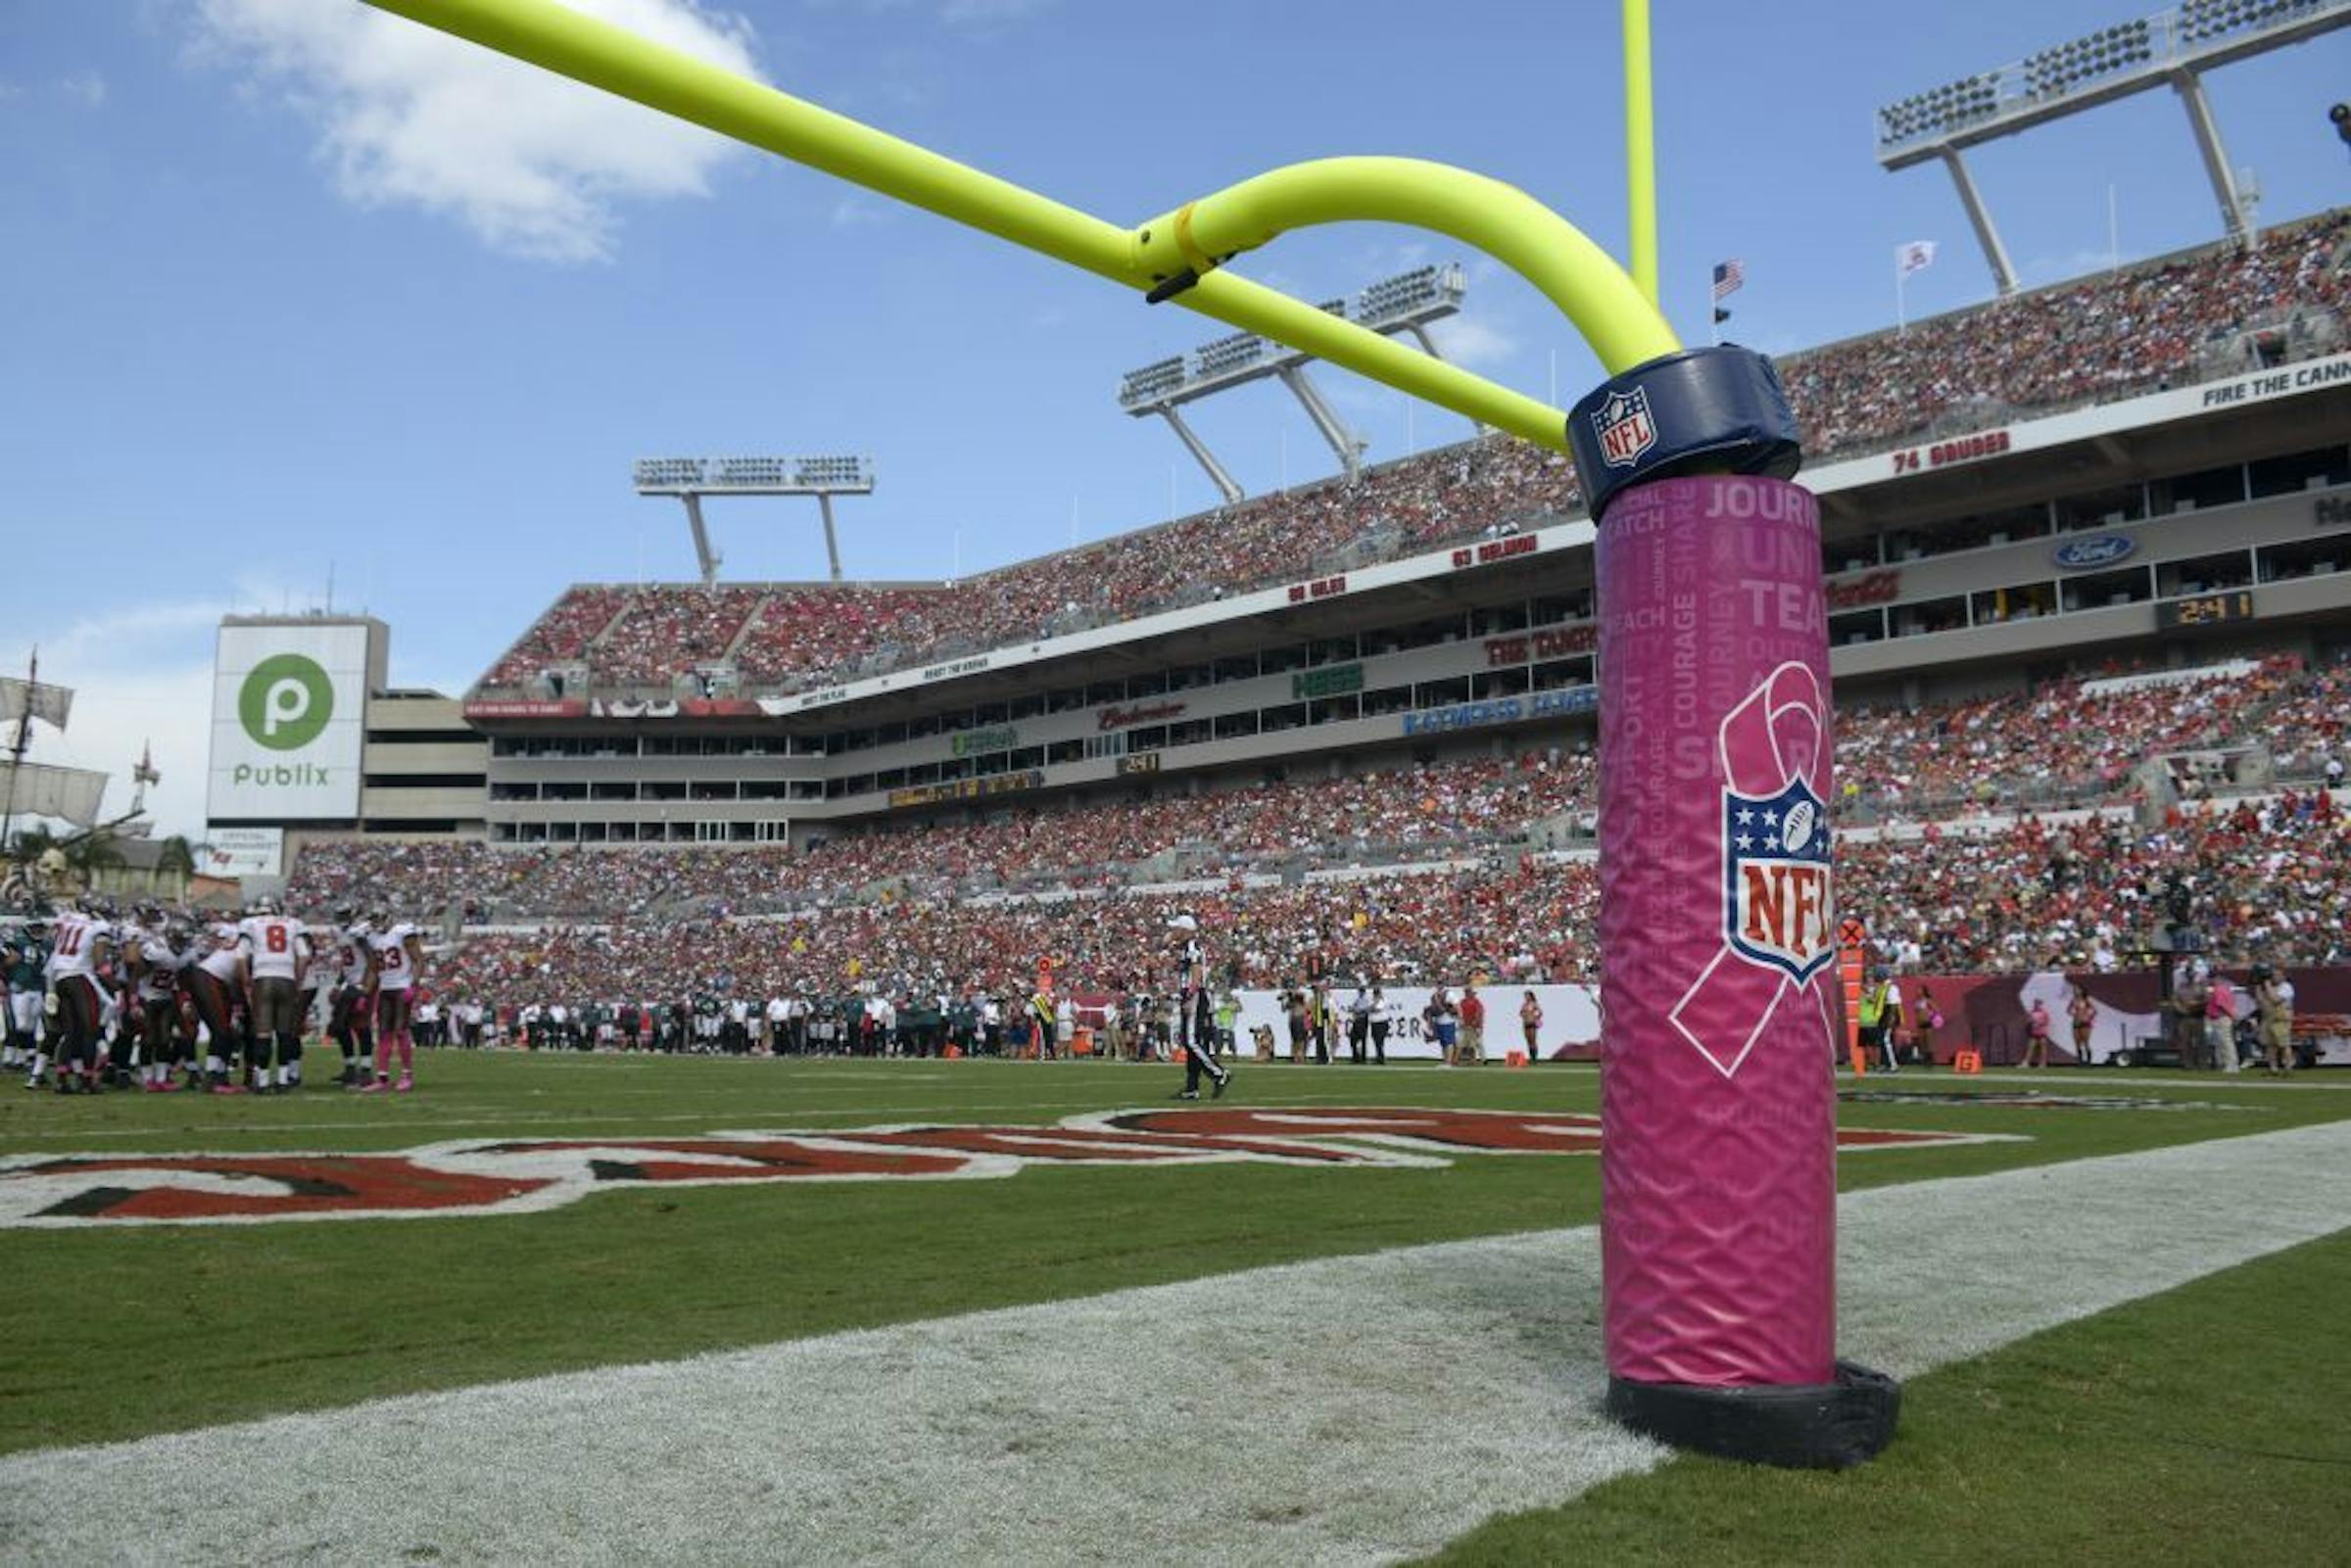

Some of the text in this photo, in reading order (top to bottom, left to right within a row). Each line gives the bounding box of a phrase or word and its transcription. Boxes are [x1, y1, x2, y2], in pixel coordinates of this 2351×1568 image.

[2204, 383, 2246, 406] FIRE
[2252, 373, 2290, 397] THE
[1604, 416, 1649, 458] NFL
[1893, 431, 2011, 474] 74 GRUBER
[1673, 484, 1697, 588] SHARE
[1673, 592, 1697, 730] COURAGE
[234, 762, 329, 785] Publix
[267, 926, 286, 953] 8
